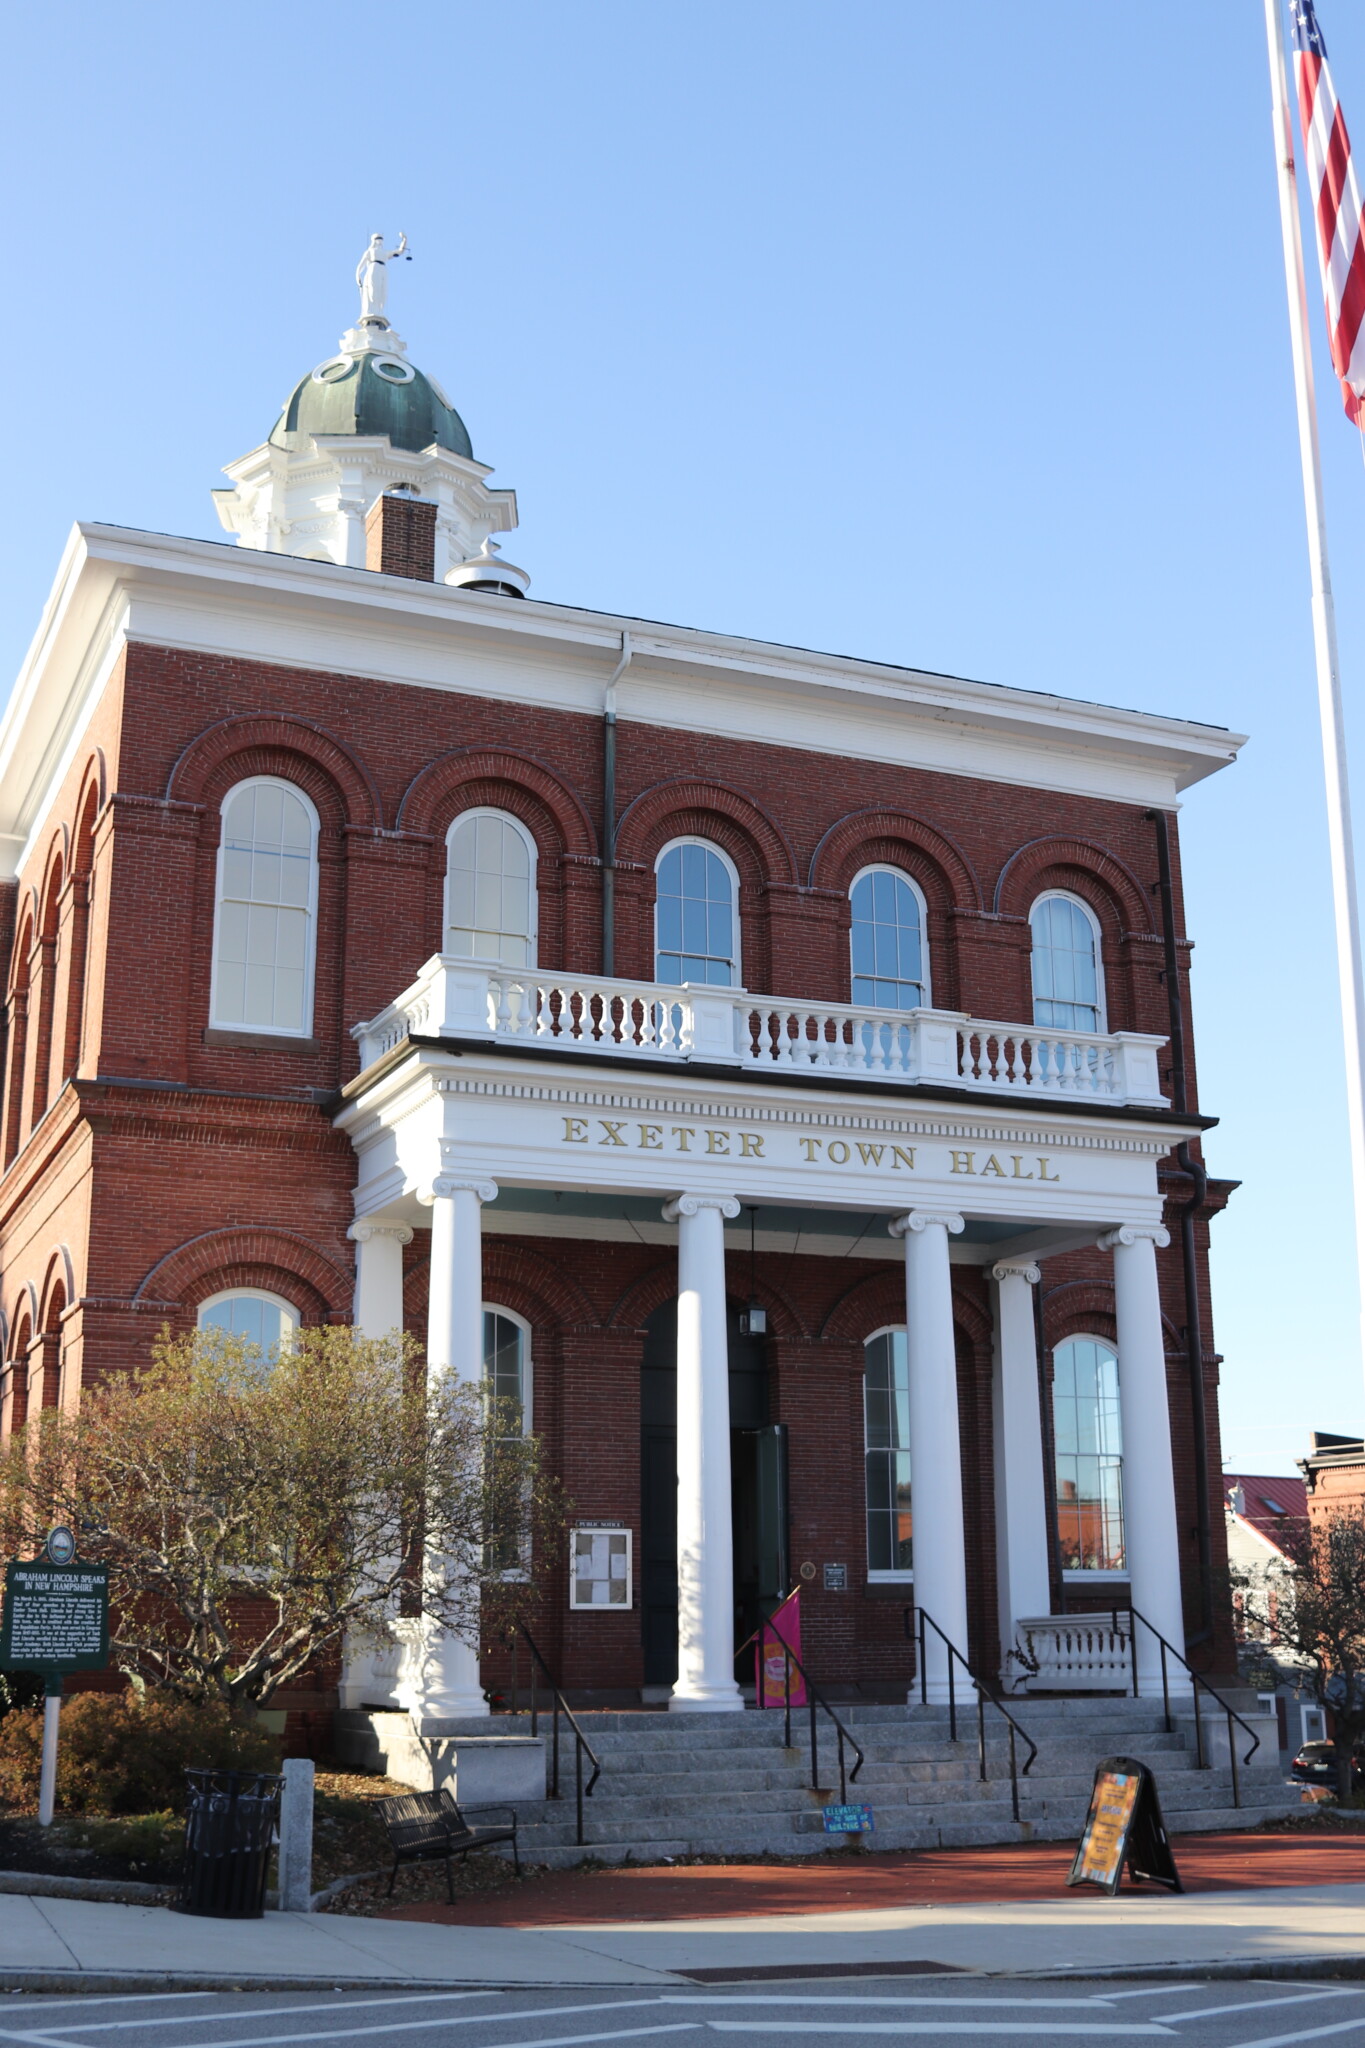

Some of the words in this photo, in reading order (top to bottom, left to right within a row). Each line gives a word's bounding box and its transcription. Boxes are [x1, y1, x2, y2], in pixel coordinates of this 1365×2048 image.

[561, 1116, 766, 1158] EXETER
[799, 1137, 917, 1170] TOWN
[949, 1150, 1060, 1182] HALL
[14, 1572, 48, 1581] ABRAHAM
[49, 1574, 79, 1582] LINCOLN
[81, 1575, 105, 1584] SPEAKS
[25, 1582, 33, 1590] IN
[35, 1582, 51, 1590] NEW
[53, 1583, 93, 1591] HAMPSHIRE
[826, 1806, 861, 1816] ELEVATOR
